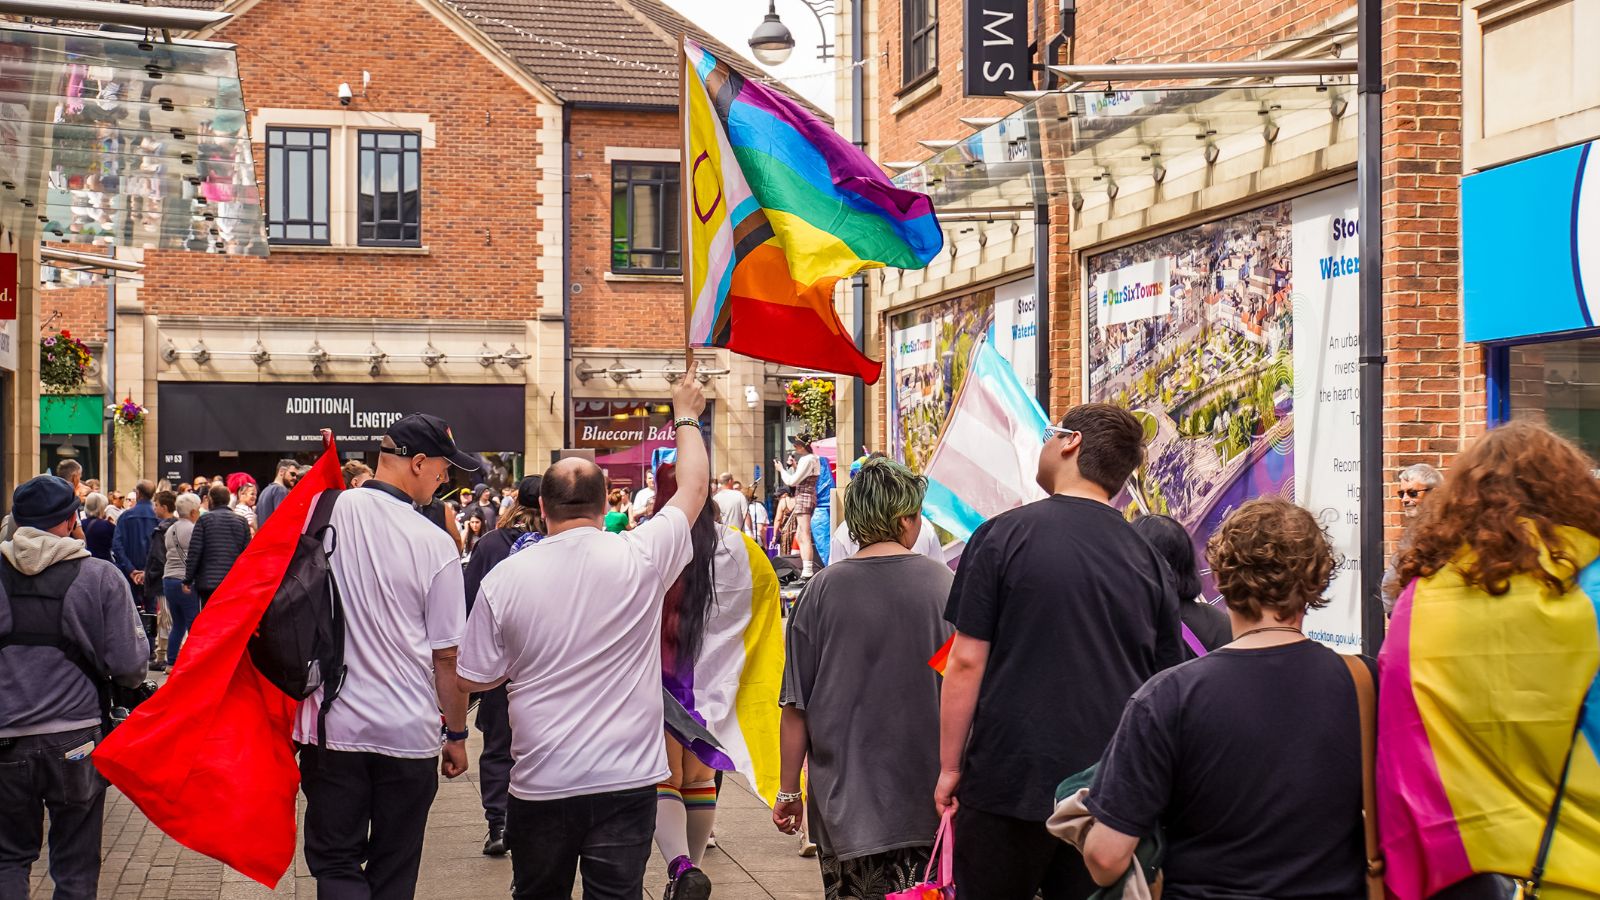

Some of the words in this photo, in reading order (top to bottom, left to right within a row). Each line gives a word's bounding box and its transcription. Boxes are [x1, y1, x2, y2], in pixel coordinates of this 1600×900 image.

[1333, 218, 1359, 241] Sto
[1103, 282, 1163, 306] #OurSixTowns
[1329, 335, 1339, 350] An
[1341, 331, 1360, 348] urba
[1319, 386, 1331, 402] the
[1333, 386, 1352, 401] heart
[581, 425, 643, 441] Bluecorn
[647, 425, 677, 441] Bak
[1346, 509, 1359, 525] the
